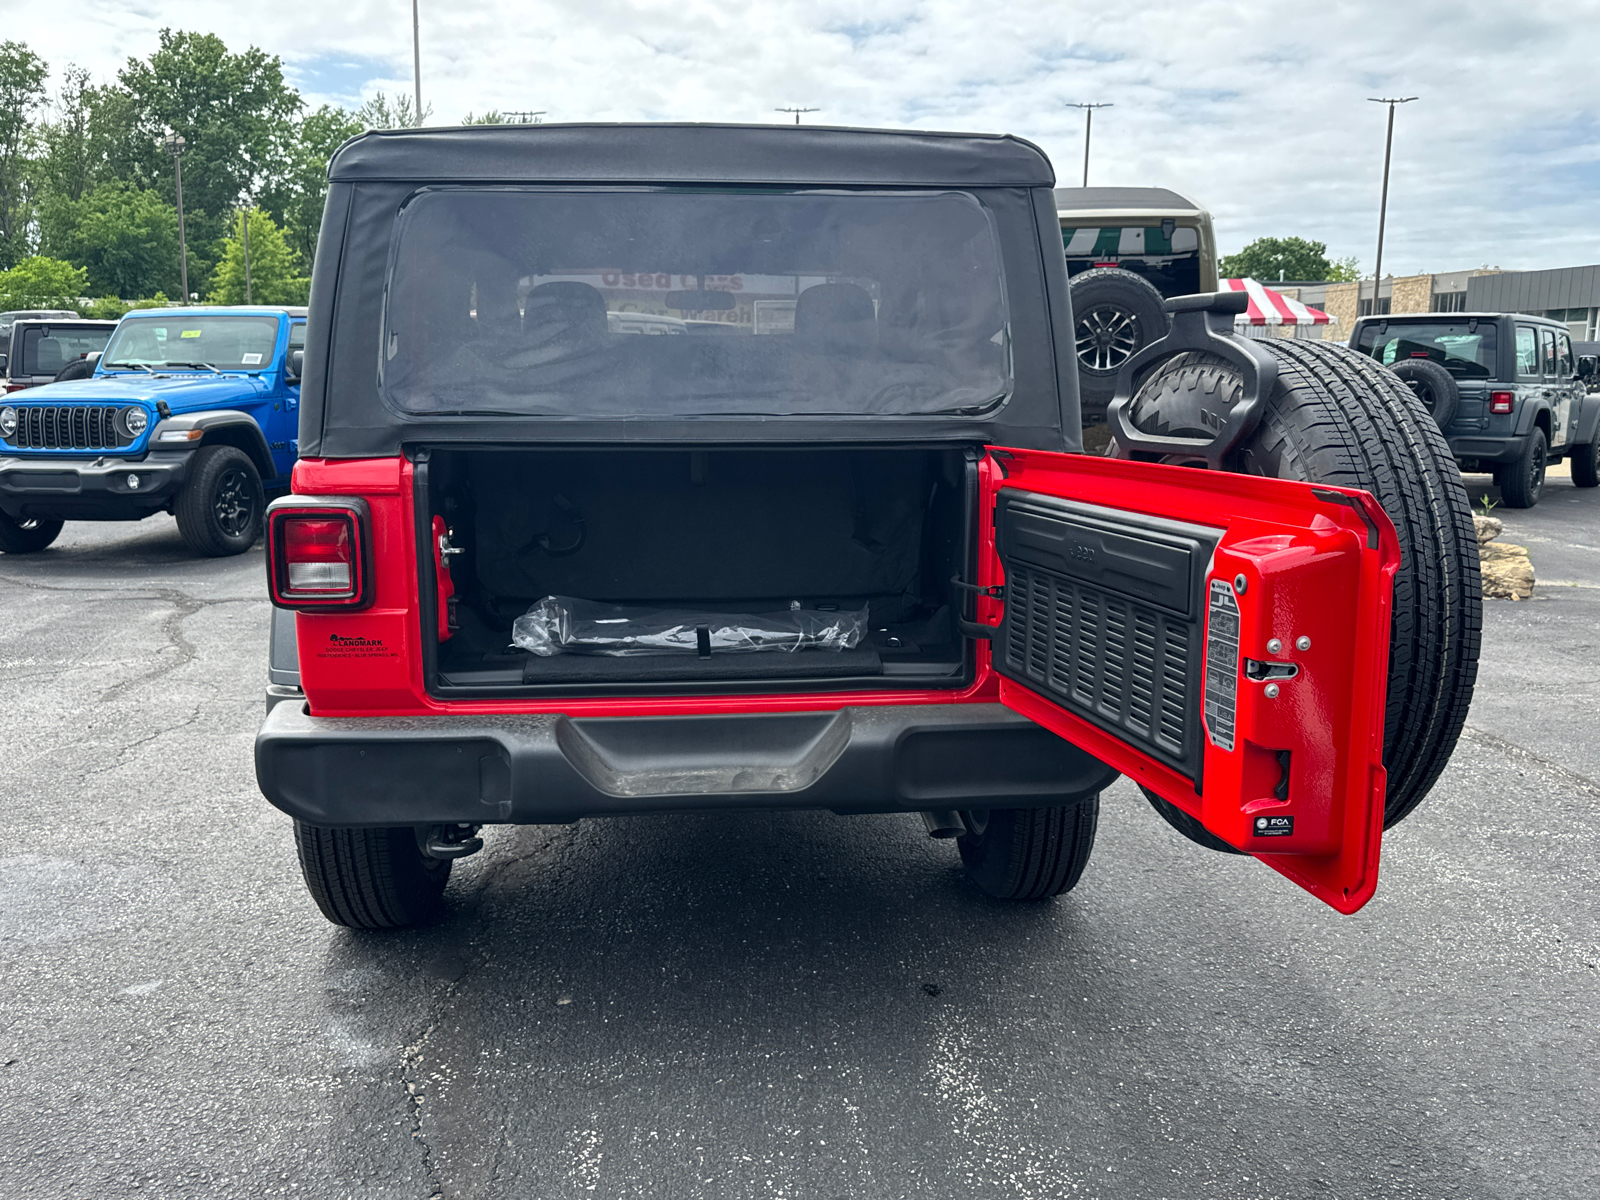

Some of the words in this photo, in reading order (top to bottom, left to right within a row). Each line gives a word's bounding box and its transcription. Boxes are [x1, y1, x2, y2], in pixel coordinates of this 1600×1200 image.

[1070, 540, 1095, 563] Jeep
[1215, 582, 1226, 592] Jeep
[1211, 595, 1236, 607] JL
[1218, 709, 1233, 722] USA
